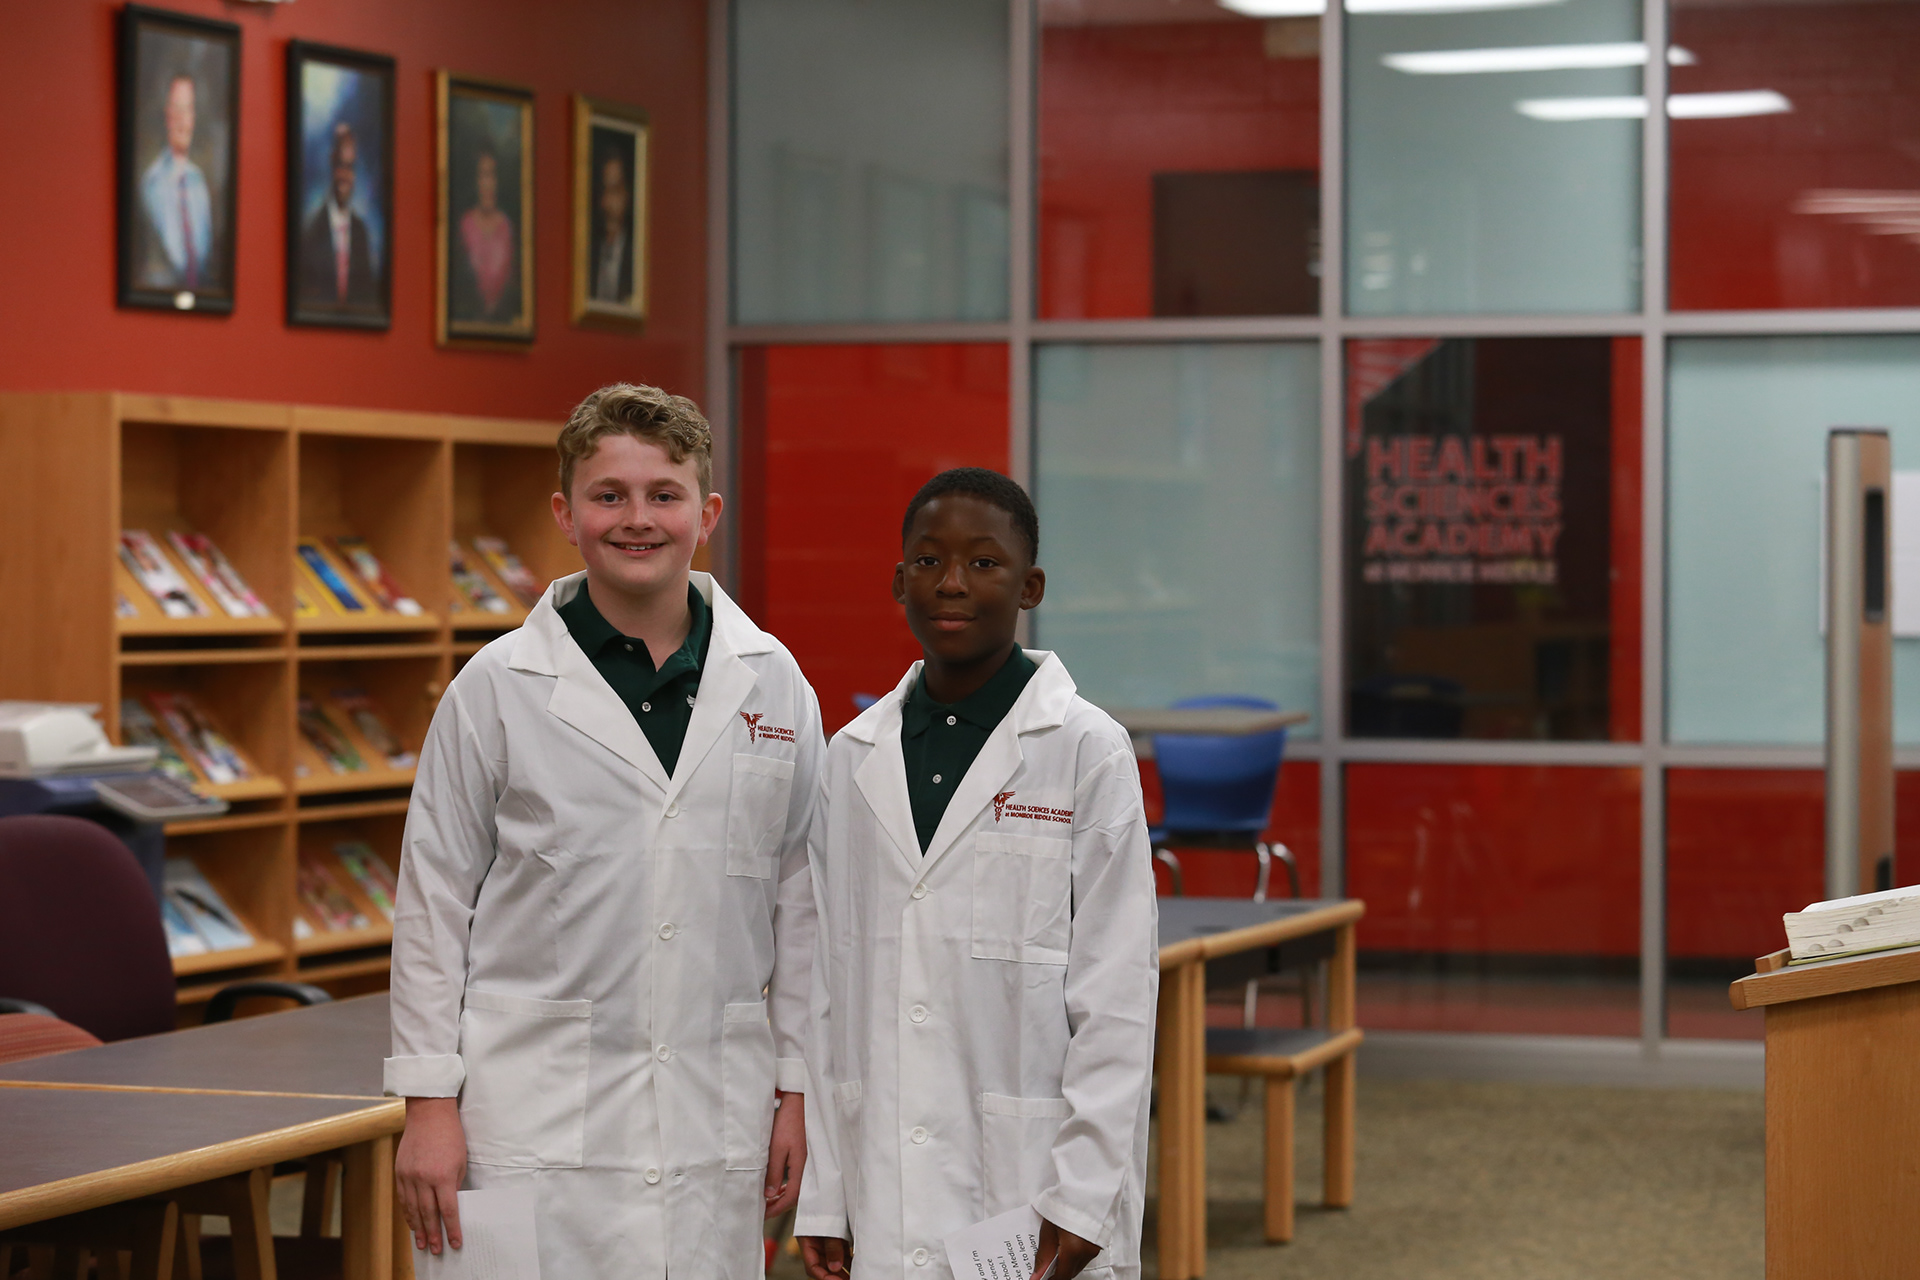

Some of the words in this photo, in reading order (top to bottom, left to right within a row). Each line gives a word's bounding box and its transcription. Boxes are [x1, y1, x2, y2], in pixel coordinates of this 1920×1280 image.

[1367, 435, 1562, 480] HEALTH
[1366, 484, 1561, 518] SCIENCES
[1364, 522, 1562, 555] ACADEMY
[1005, 804, 1027, 812] HEALTH
[1027, 805, 1050, 814] SCIENCES
[1052, 816, 1071, 824] SCHOOL
[1015, 1233, 1026, 1252] learn
[1003, 1240, 1019, 1268] Medical
[1022, 1253, 1029, 1261] to
[974, 1262, 985, 1276] and
[1025, 1262, 1033, 1271] us
